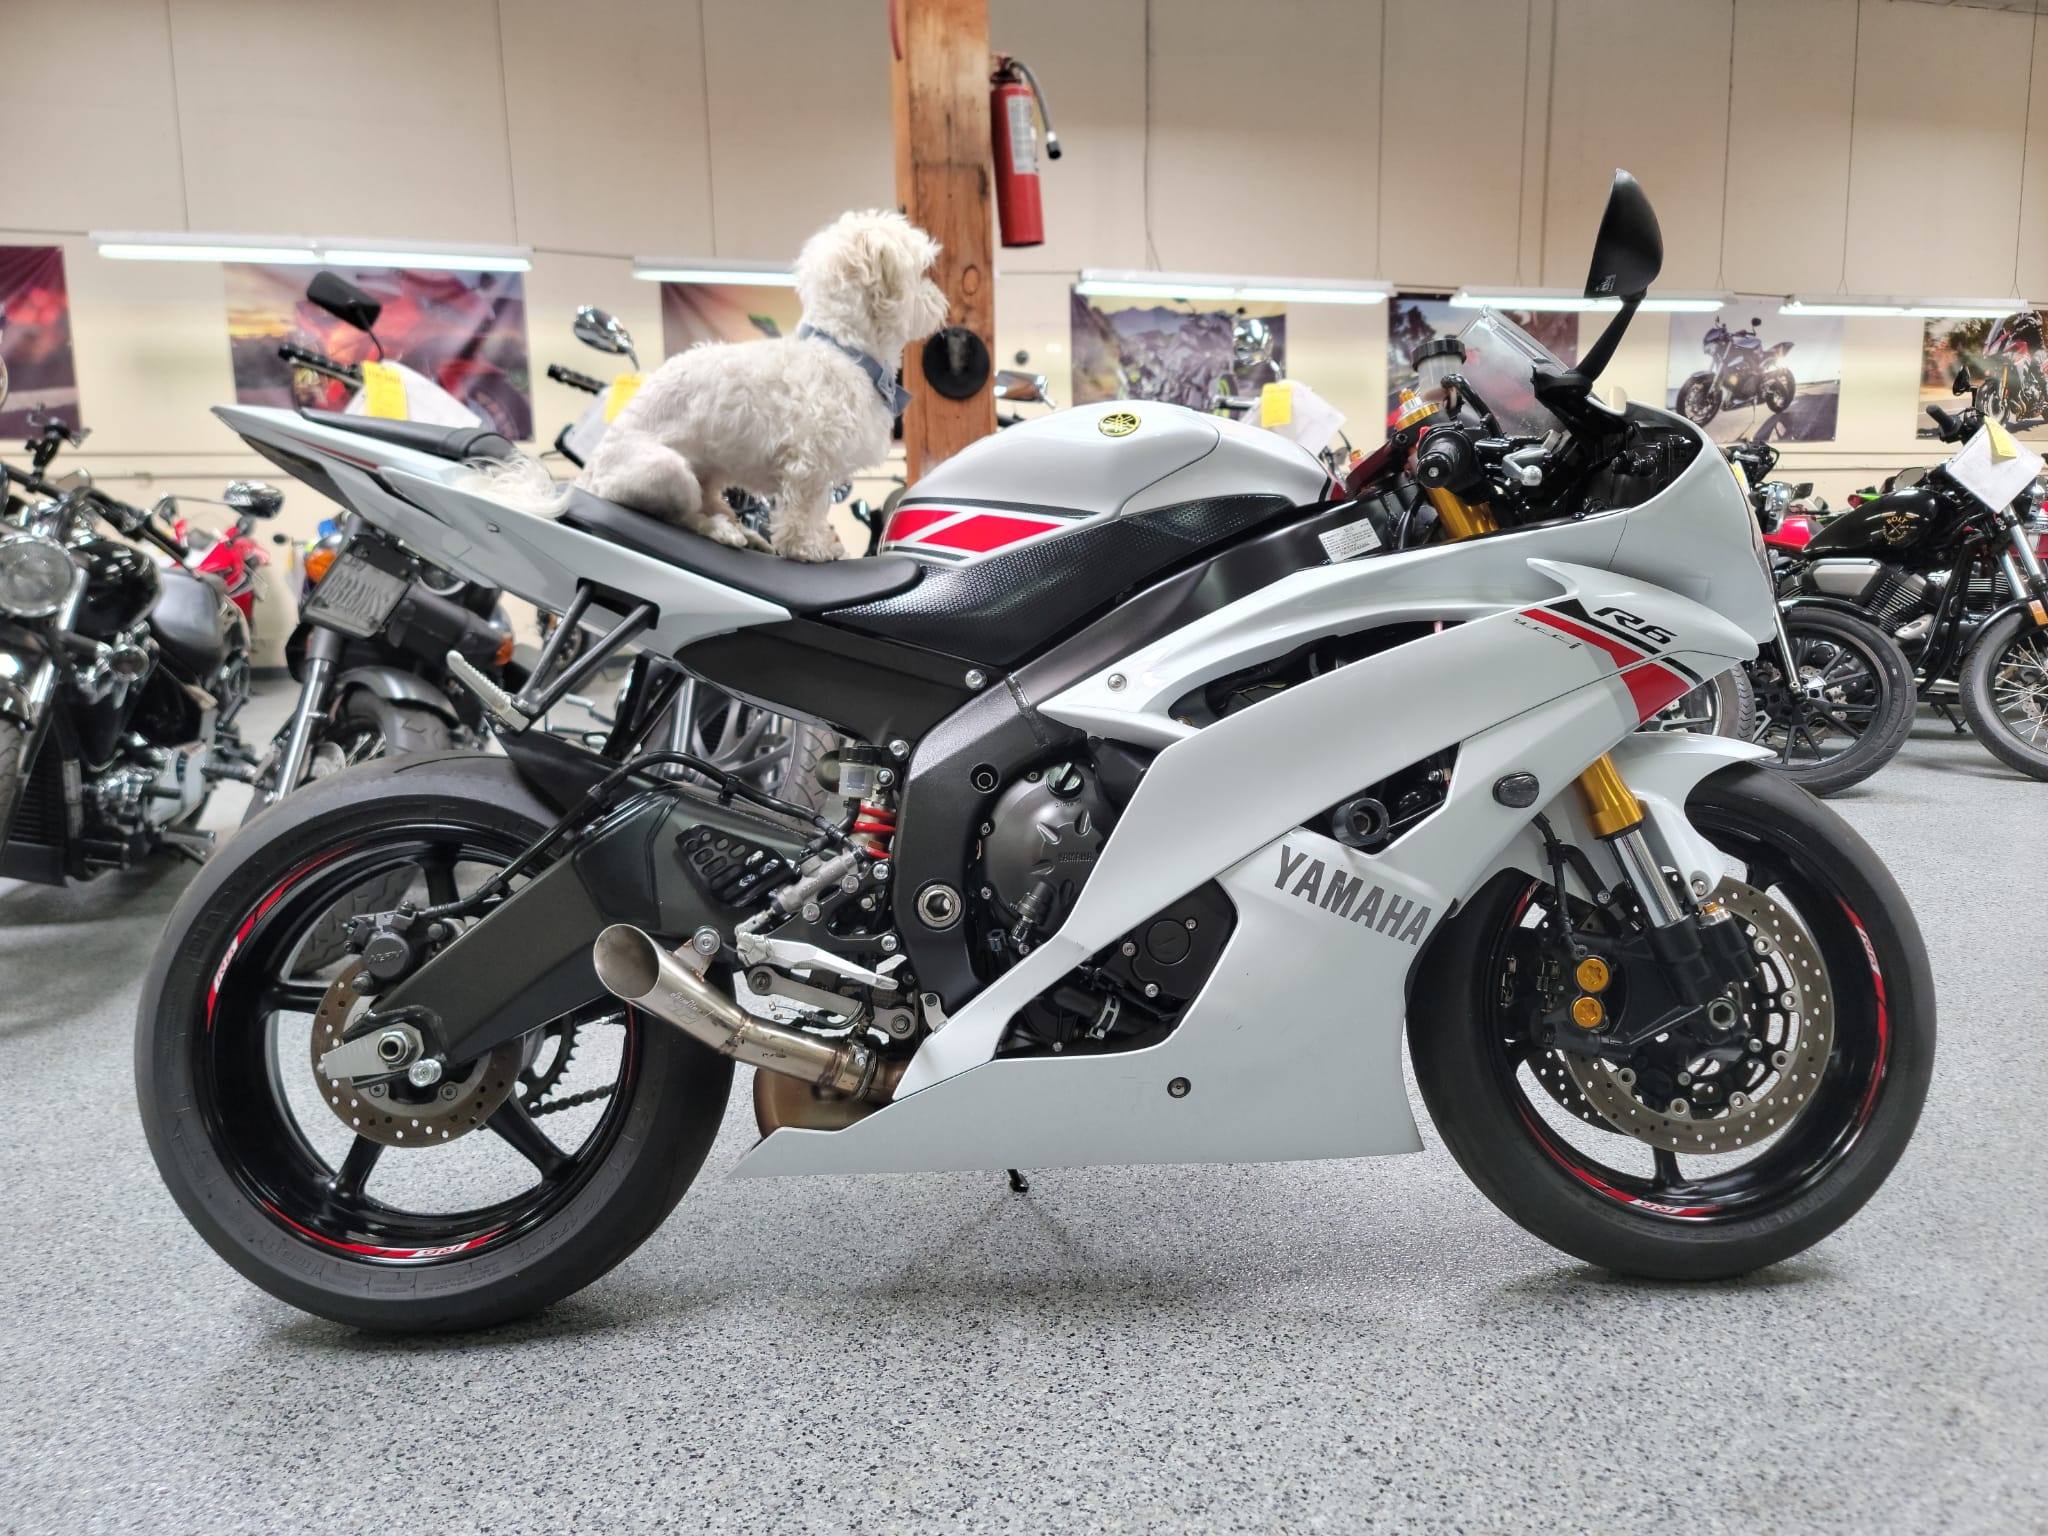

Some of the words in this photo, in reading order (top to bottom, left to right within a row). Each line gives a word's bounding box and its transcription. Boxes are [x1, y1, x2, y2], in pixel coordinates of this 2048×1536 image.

[1885, 515, 1908, 525] BOLT
[1593, 606, 1678, 645] R6
[1273, 843, 1432, 946] YAMAHA
